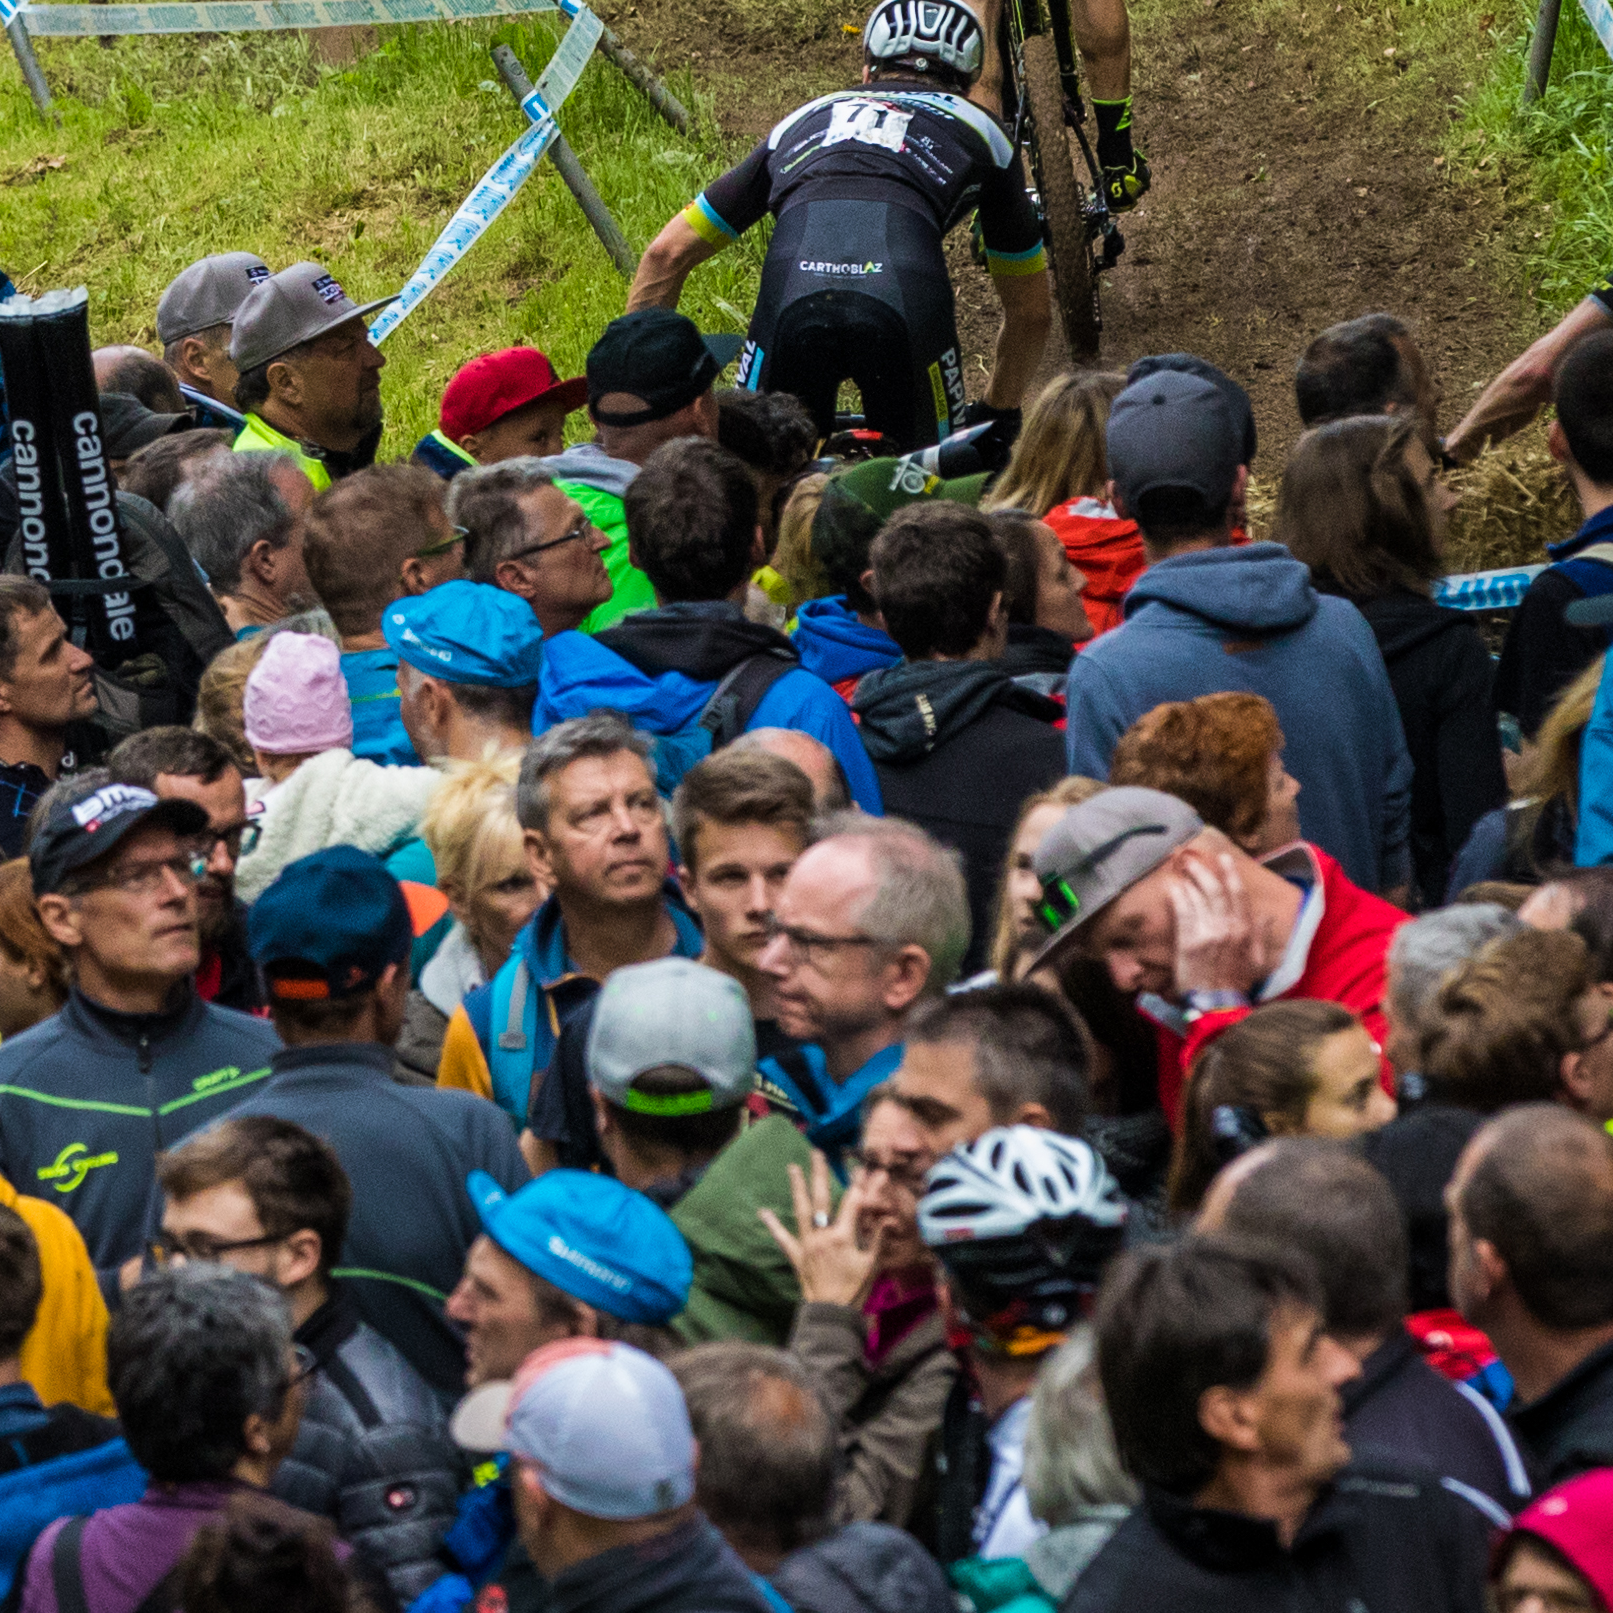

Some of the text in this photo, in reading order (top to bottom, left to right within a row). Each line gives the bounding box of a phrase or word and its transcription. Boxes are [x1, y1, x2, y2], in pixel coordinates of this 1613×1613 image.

[846, 103, 888, 129] 71
[799, 259, 884, 275] CARTHOBLAZ
[72, 410, 135, 641] cannondale
